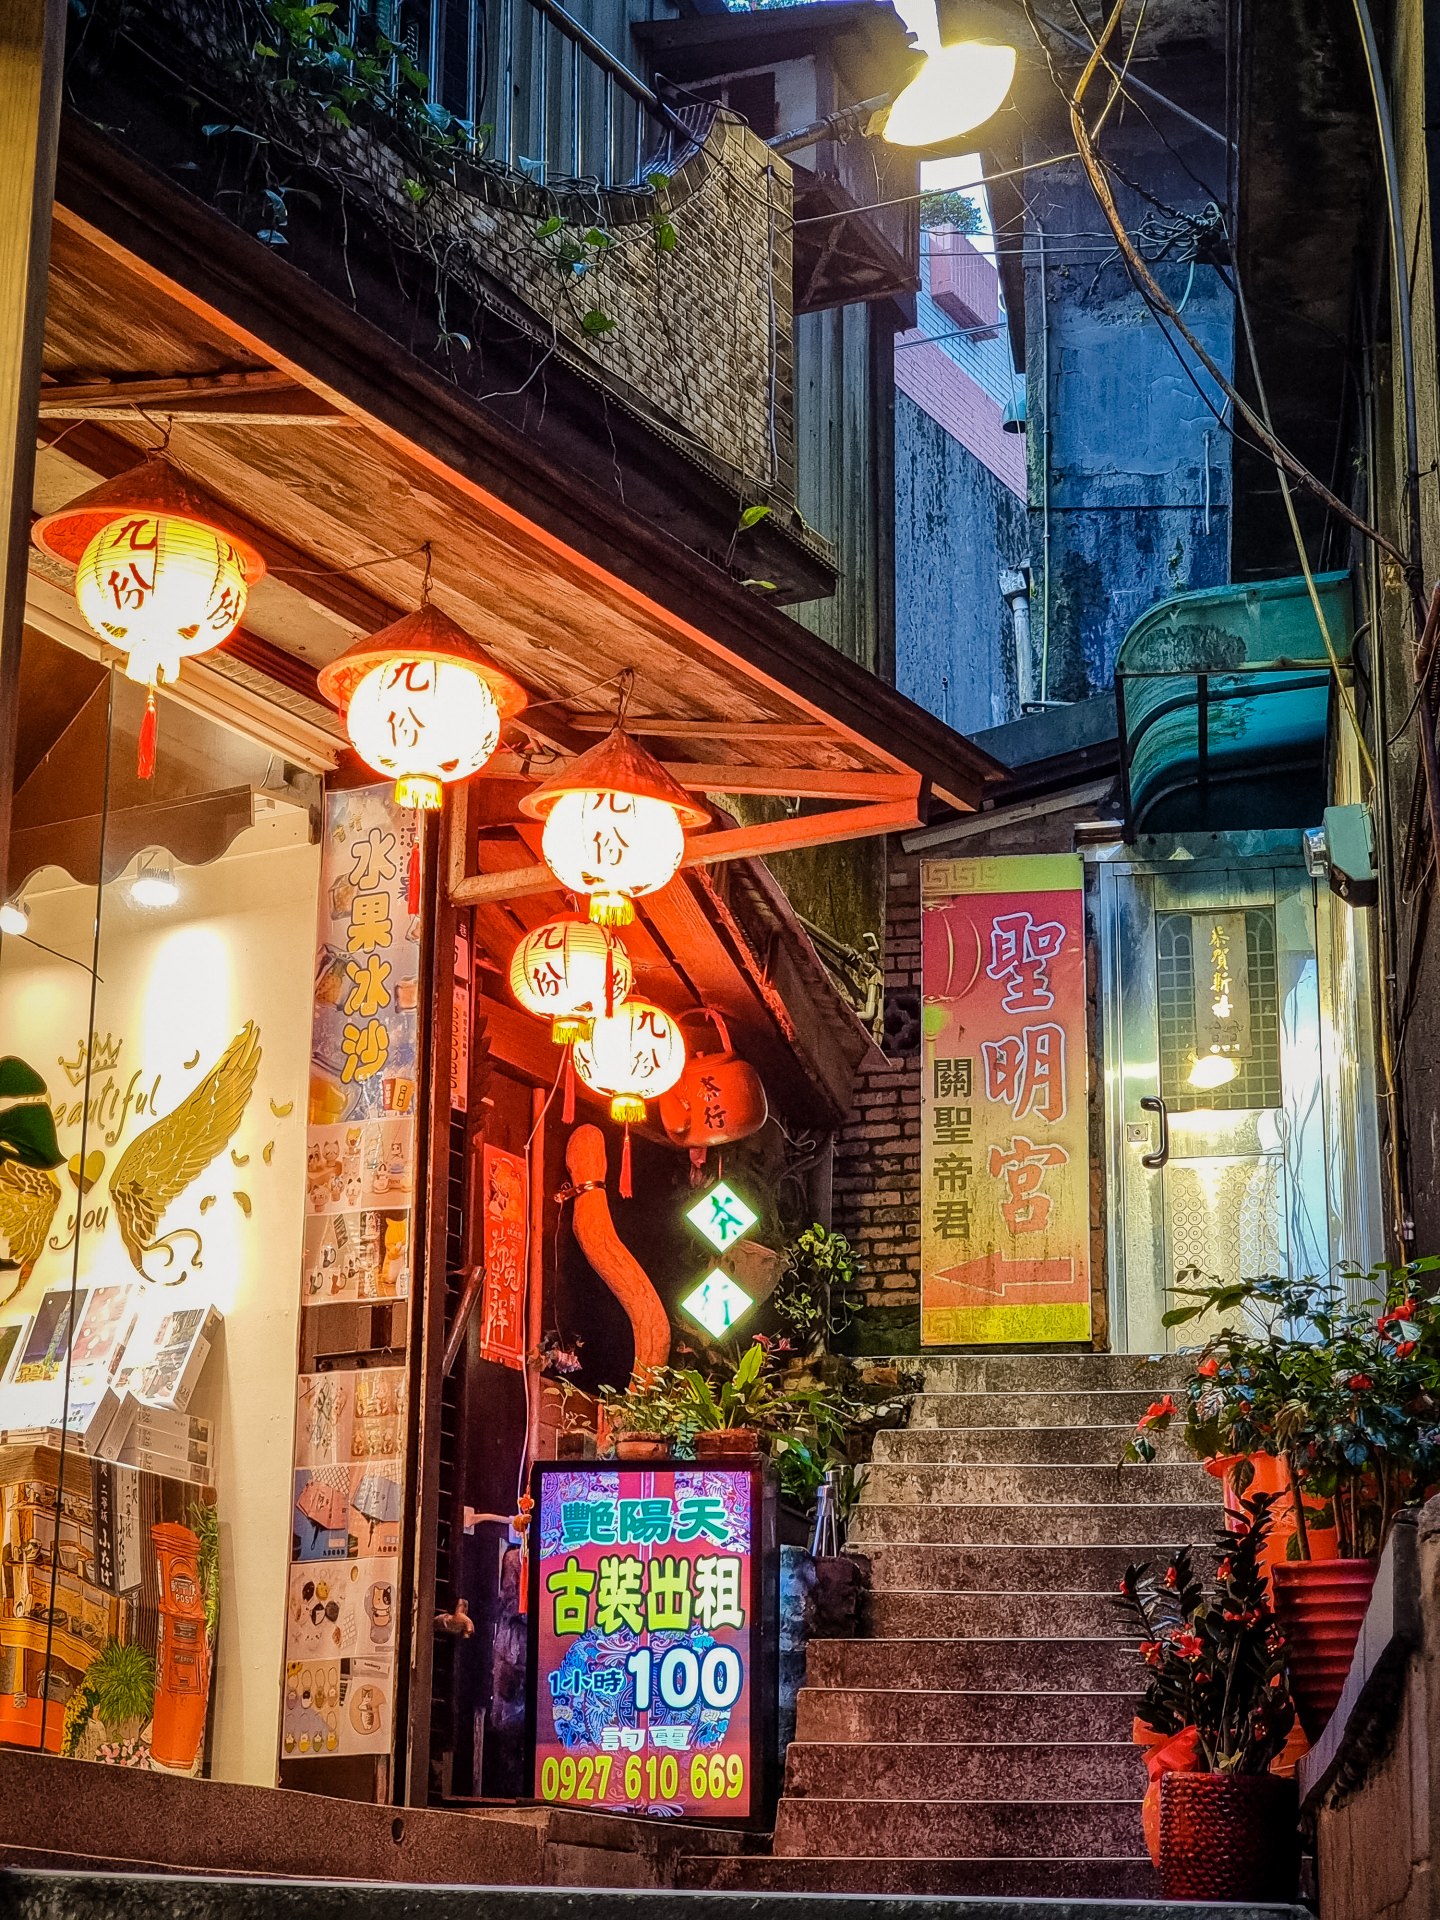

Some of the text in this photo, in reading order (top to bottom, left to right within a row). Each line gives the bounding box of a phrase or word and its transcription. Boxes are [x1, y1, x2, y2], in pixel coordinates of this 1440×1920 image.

[109, 519, 158, 610] 九份
[387, 661, 426, 748] 九份
[341, 827, 396, 1084] 水果冰沙
[530, 926, 565, 997] 九份
[631, 1010, 667, 1079] 九份
[980, 911, 1068, 1237] 聖明宮
[46, 1069, 161, 1147] eautiful
[697, 1076, 727, 1129] 茶行
[933, 1058, 973, 1240] 關聖帝君
[50, 1206, 109, 1250] you
[175, 1593, 193, 1604] POST
[547, 1553, 746, 1636] 古裝出租
[548, 1646, 743, 1711] 1小時 100
[541, 1753, 744, 1801] 0927 610 669
